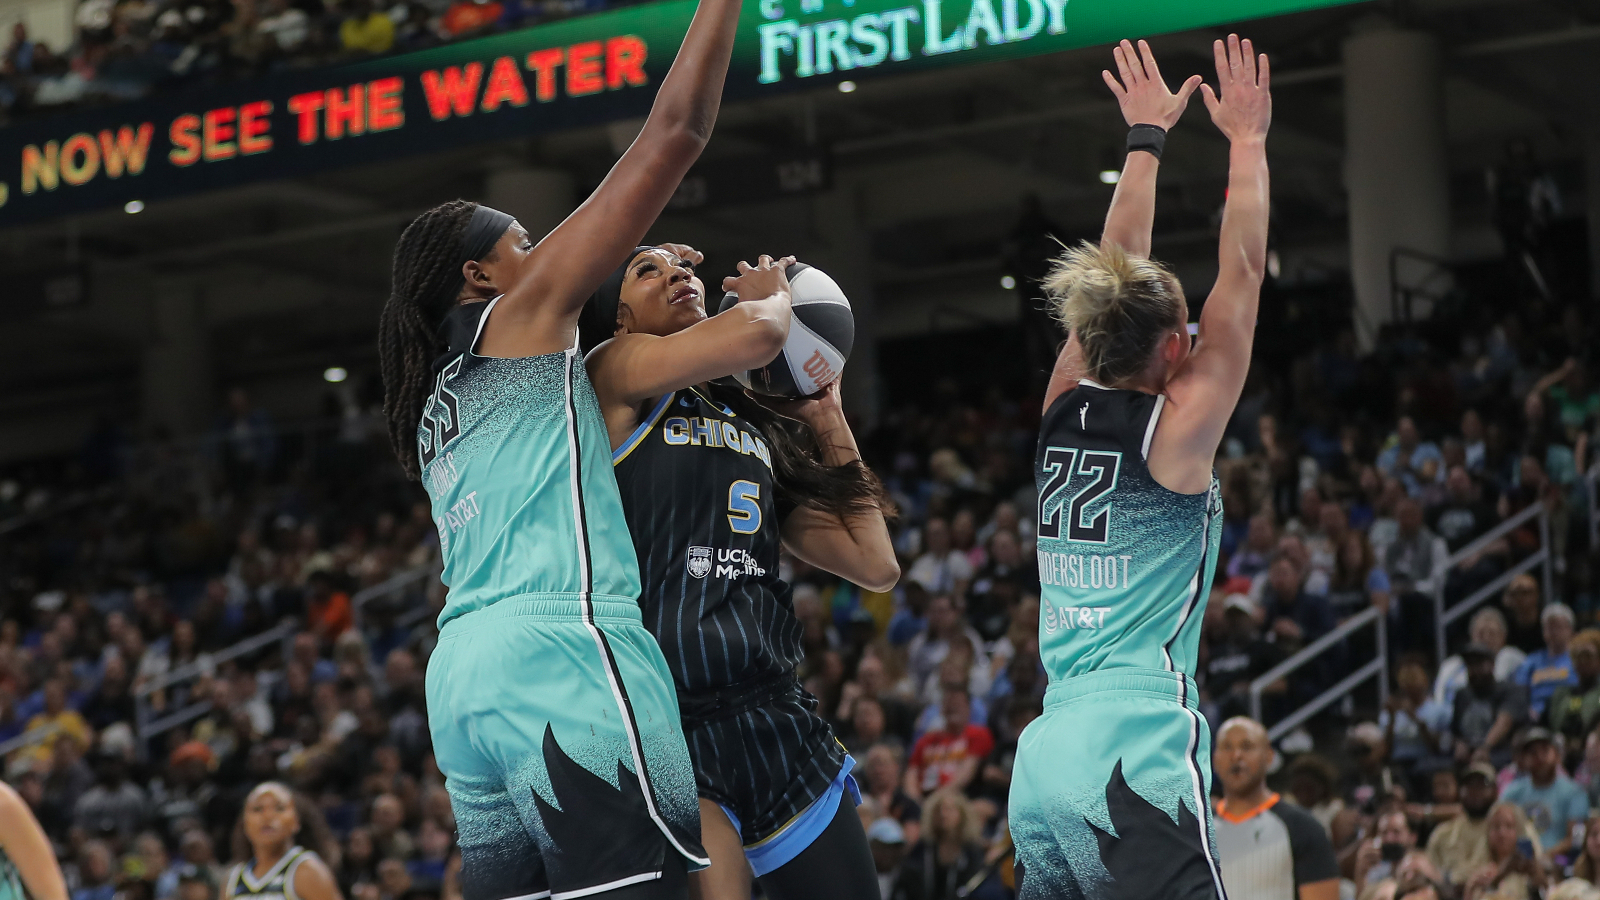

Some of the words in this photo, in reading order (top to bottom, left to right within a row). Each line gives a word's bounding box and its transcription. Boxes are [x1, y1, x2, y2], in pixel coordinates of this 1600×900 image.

[757, 7, 920, 84] FIRST
[921, 0, 1068, 55] LADY
[21, 121, 155, 196] NOW
[168, 101, 273, 167] SEE
[288, 77, 405, 145] THE
[421, 36, 648, 121] WATER
[803, 348, 836, 391] Wil
[664, 416, 773, 477] CHICAG
[445, 490, 480, 534] AT&T
[727, 479, 762, 535] 5
[1037, 445, 1122, 546] 22
[1058, 606, 1111, 630] AT&T
